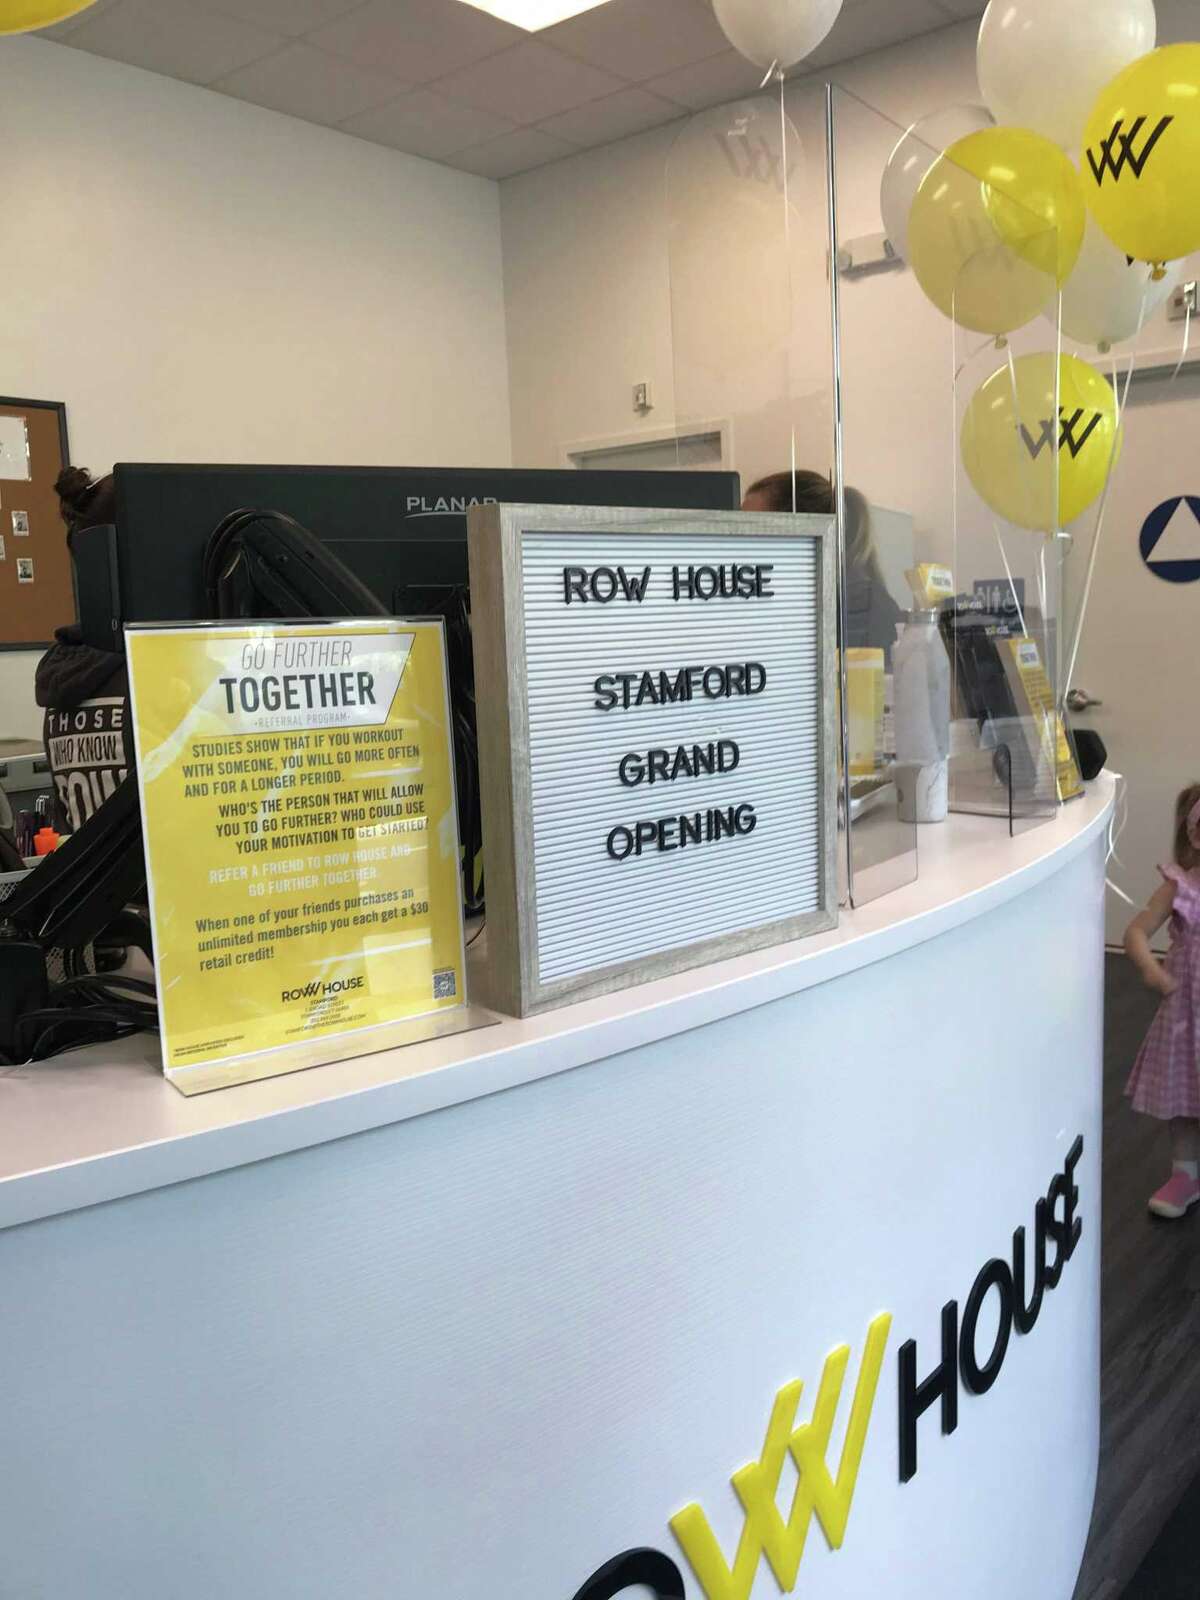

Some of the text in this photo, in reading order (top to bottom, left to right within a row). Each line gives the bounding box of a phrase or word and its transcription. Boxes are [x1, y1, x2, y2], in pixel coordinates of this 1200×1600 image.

[562, 563, 774, 605] ROW HOUSE
[242, 639, 353, 669] GO FURTHER
[219, 671, 376, 714] TOGETHER
[594, 662, 767, 711] STAMFORD
[48, 708, 123, 734] THOSE
[53, 735, 117, 767] WHO KNOW
[182, 744, 420, 778] WITH SOMEONE, YOU WILL GO MORE OFTEN
[192, 728, 404, 758] STUDIES SHOW THAT IF YOU WORKOUT
[618, 740, 740, 787] GRAND
[184, 770, 345, 798] AND FOR A LONGER PERIOD.
[219, 784, 424, 818] WHO'S THE PERSON THAT WILL ALLOW
[216, 801, 425, 837] YOU TO GO FURTHER? WHO COULD USE
[236, 818, 430, 854] YOUR MOTIVATION TO GET STARTED?
[606, 803, 757, 861] OPENING
[208, 867, 248, 884] REFER
[252, 864, 259, 878] A
[262, 859, 304, 876] FRIEND
[308, 856, 321, 869] TO
[324, 852, 350, 867] ROW
[352, 847, 388, 862] HOUSE
[248, 867, 377, 897] GO FURTHER TOGETHER
[195, 888, 415, 933] When one of your friends purchases an
[198, 901, 429, 952] unlimited membership you each get a $30
[199, 946, 275, 972] retail credit!
[282, 976, 364, 1003] ROW HOUSE
[898, 1134, 1083, 1484] HOUSE
